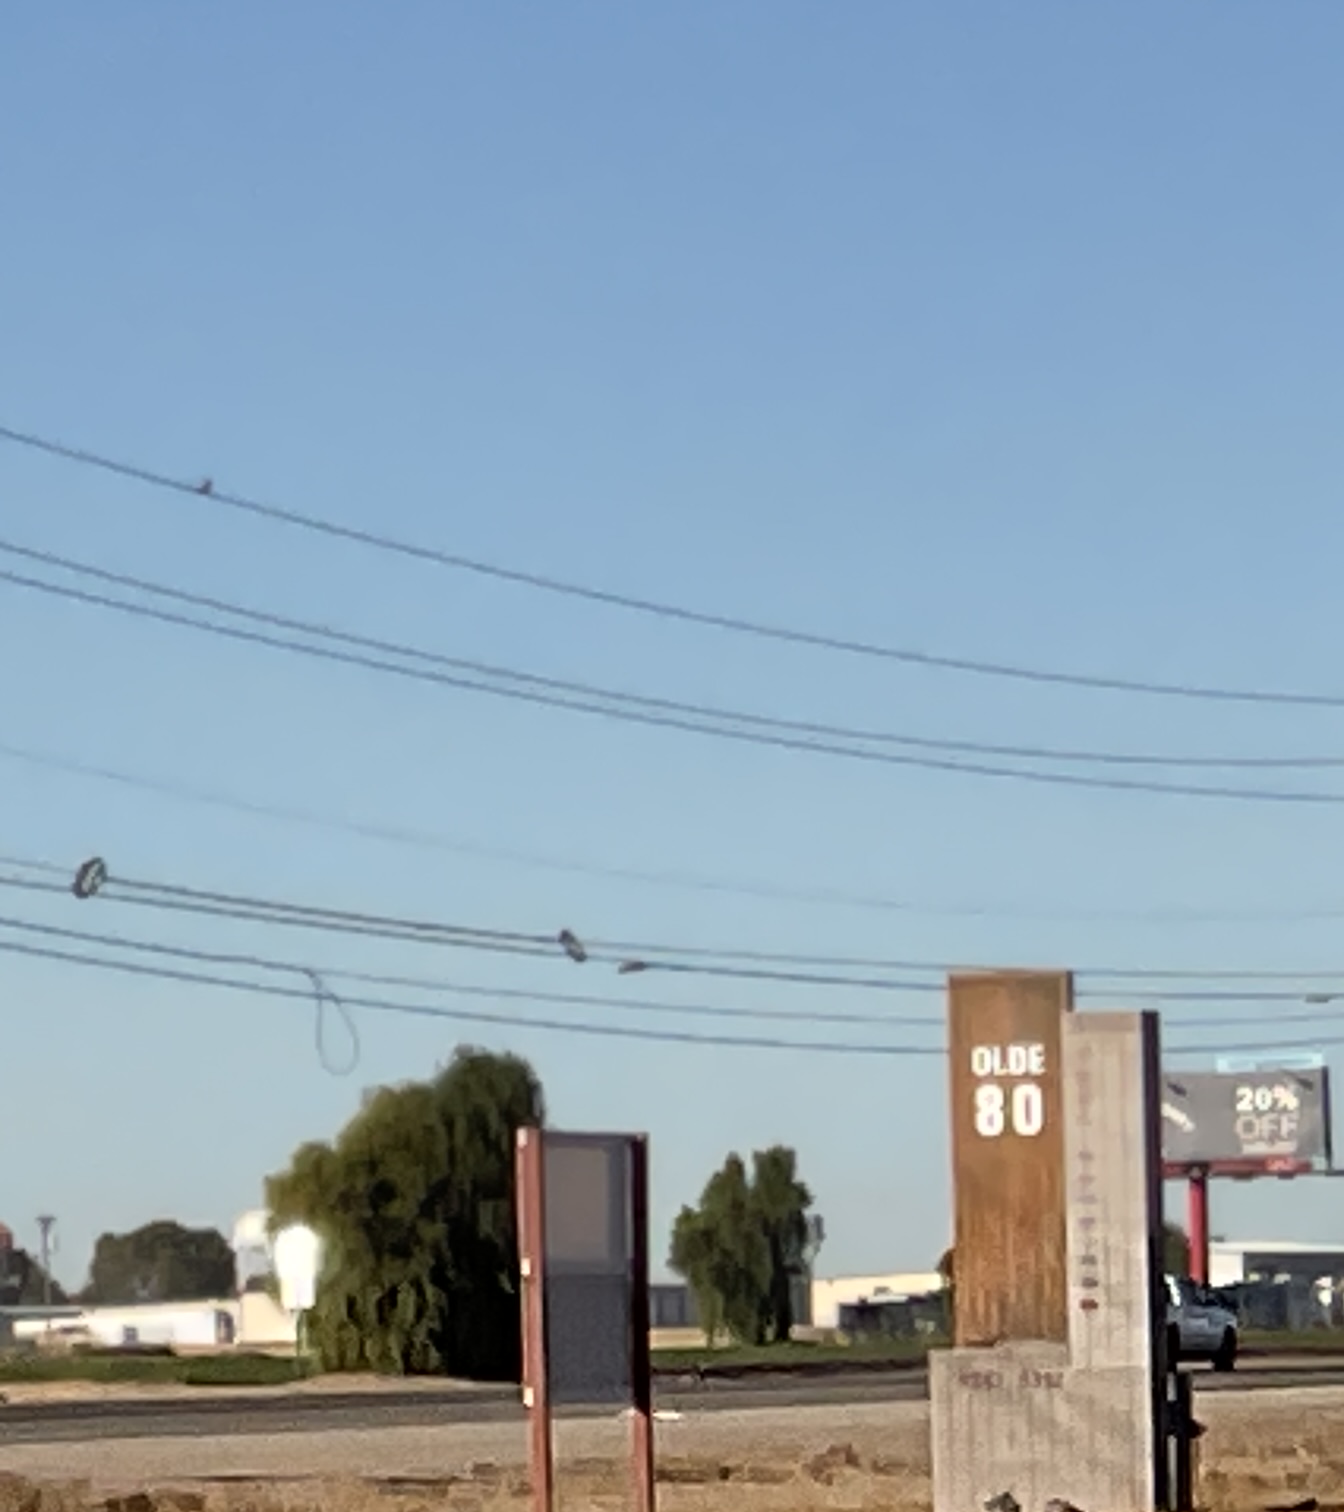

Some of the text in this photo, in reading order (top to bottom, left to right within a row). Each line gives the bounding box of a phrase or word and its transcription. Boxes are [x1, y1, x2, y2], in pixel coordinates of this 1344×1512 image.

[971, 1044, 1046, 1076] OLDE
[975, 1083, 1042, 1136] 80
[1235, 1086, 1299, 1111] 20%
[1235, 1113, 1298, 1140] OFF
